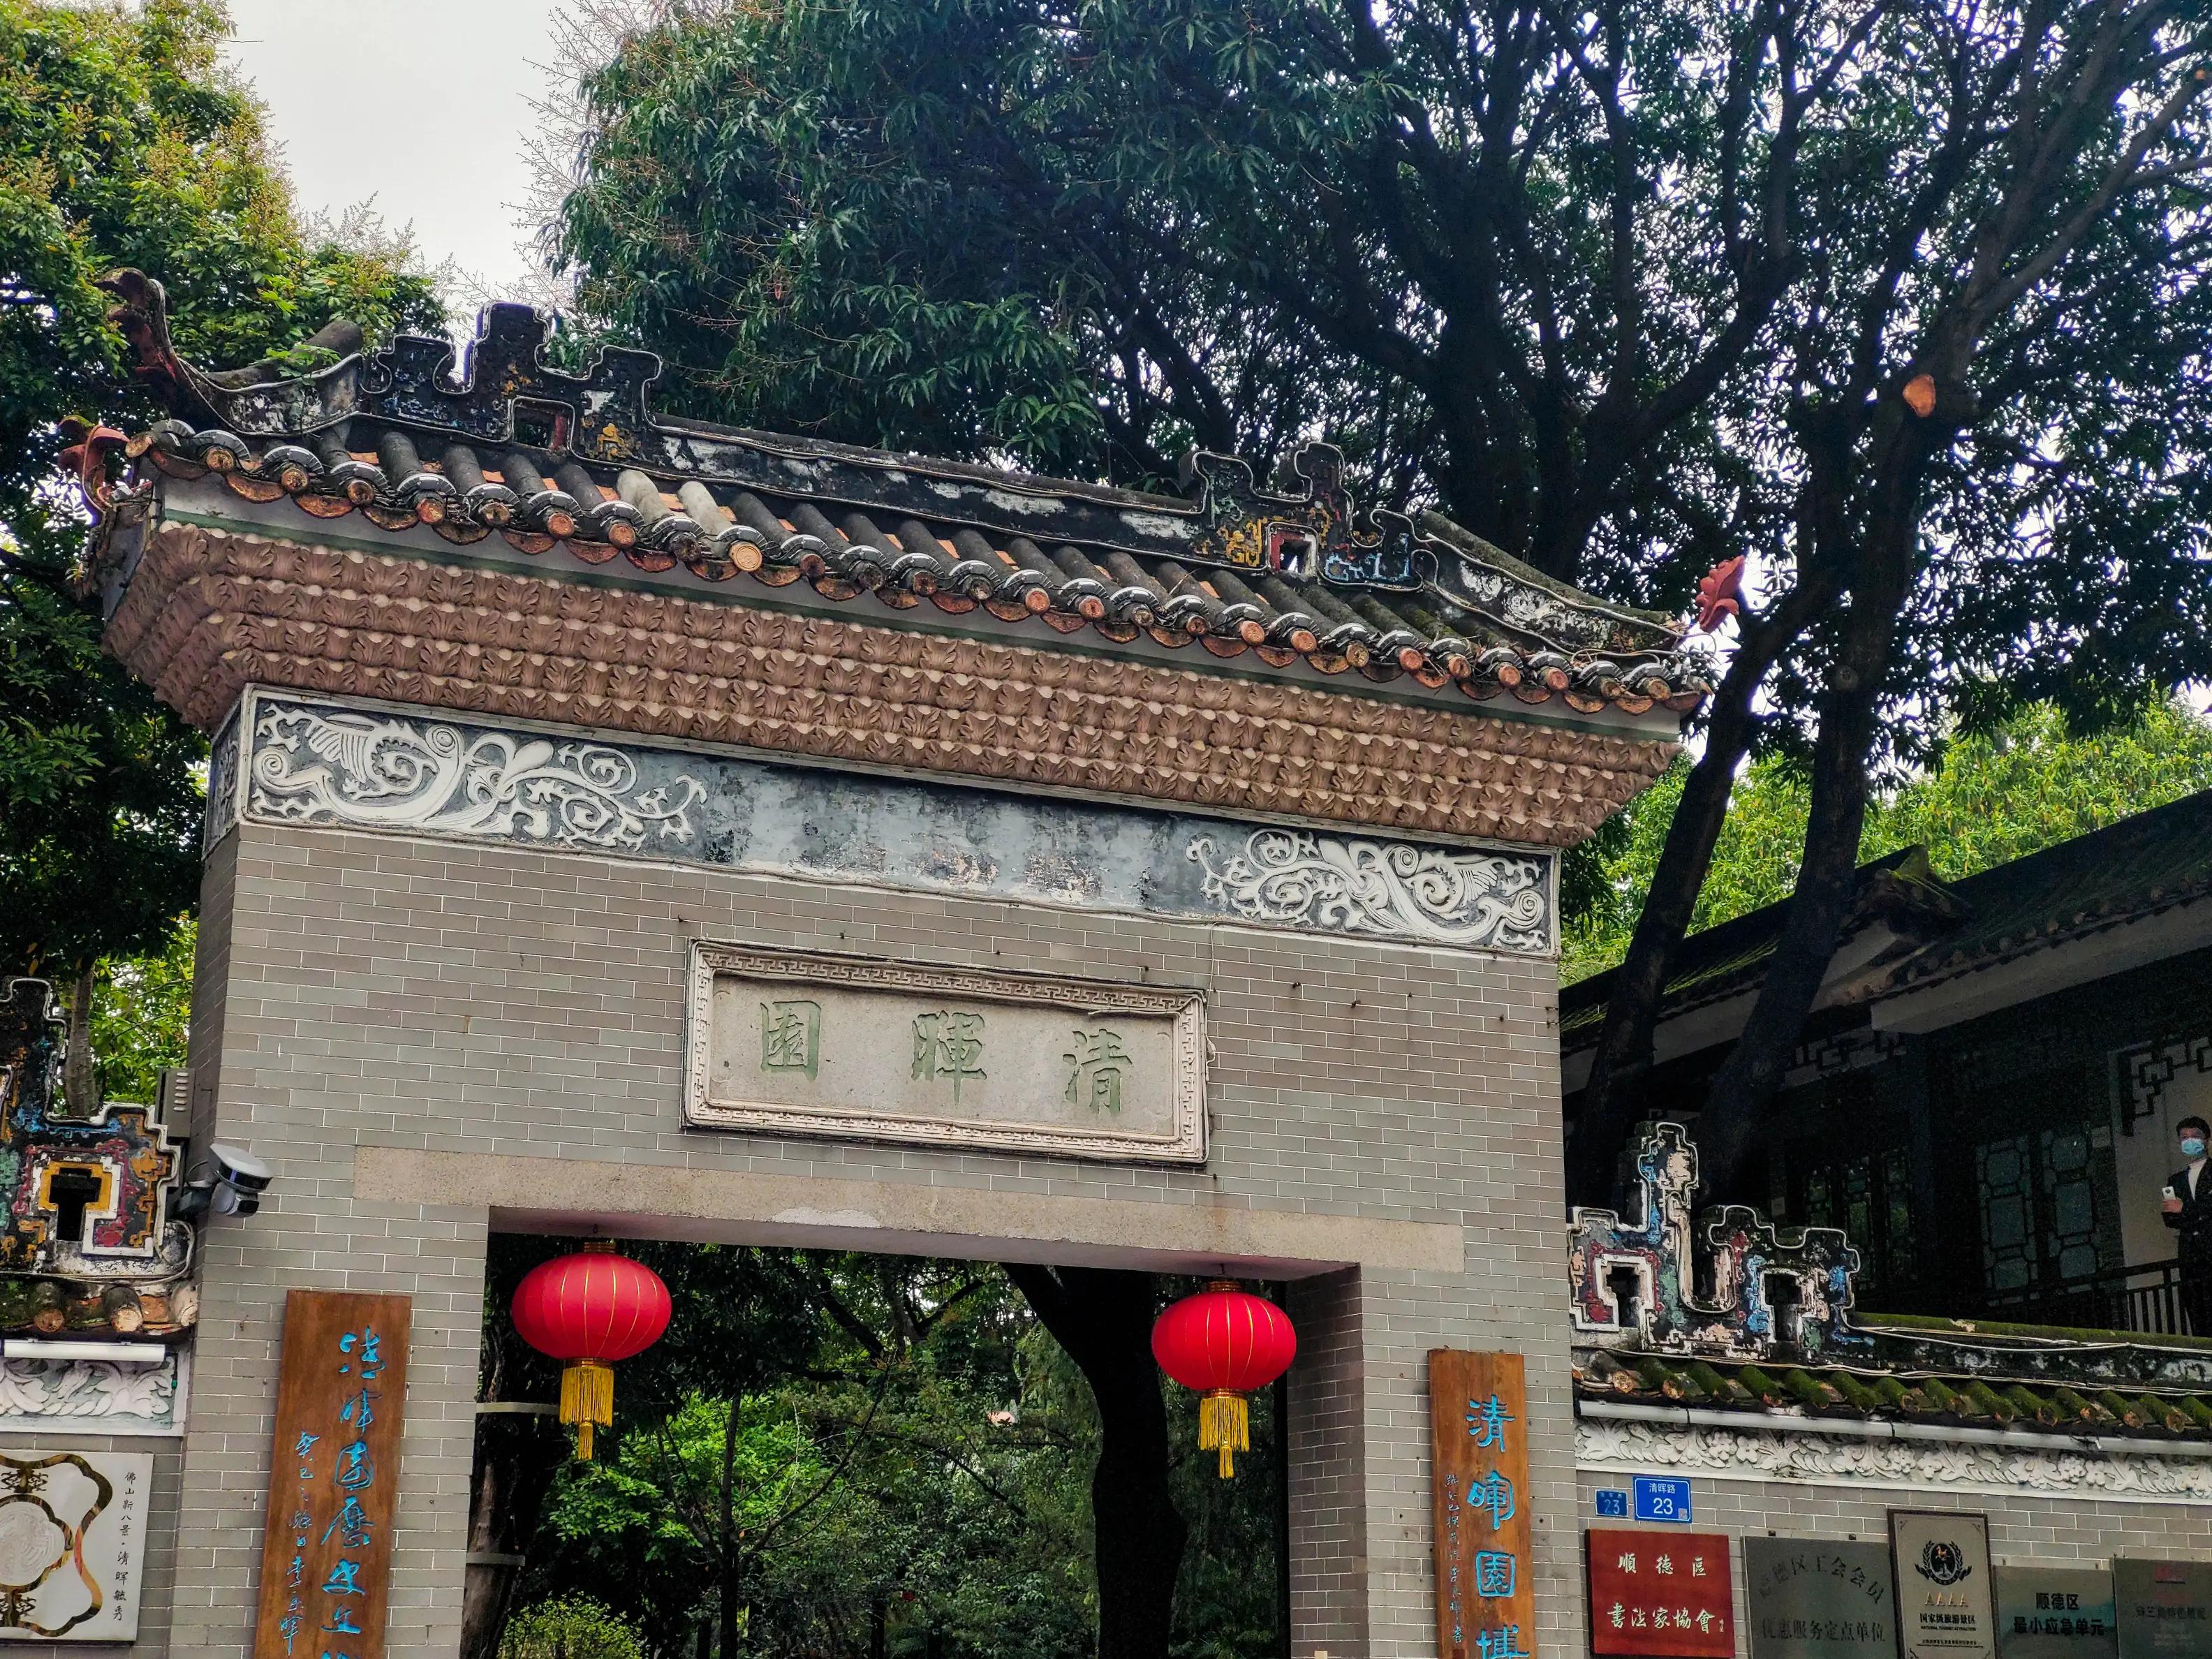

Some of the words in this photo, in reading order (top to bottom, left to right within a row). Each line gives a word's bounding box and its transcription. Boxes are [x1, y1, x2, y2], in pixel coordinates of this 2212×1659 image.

[1649, 1482, 1676, 1494] 清晖路
[1605, 1499, 1620, 1514] 23
[1653, 1497, 1674, 1515] 23
[1925, 1591, 1968, 1607] AAAA
[2035, 1592, 2080, 1611] 顺德区
[1607, 1601, 1716, 1635] 書法家協會
[2014, 1616, 2104, 1637] 最小应急单元
[1762, 1617, 1886, 1642] 优惠服务定点单位
